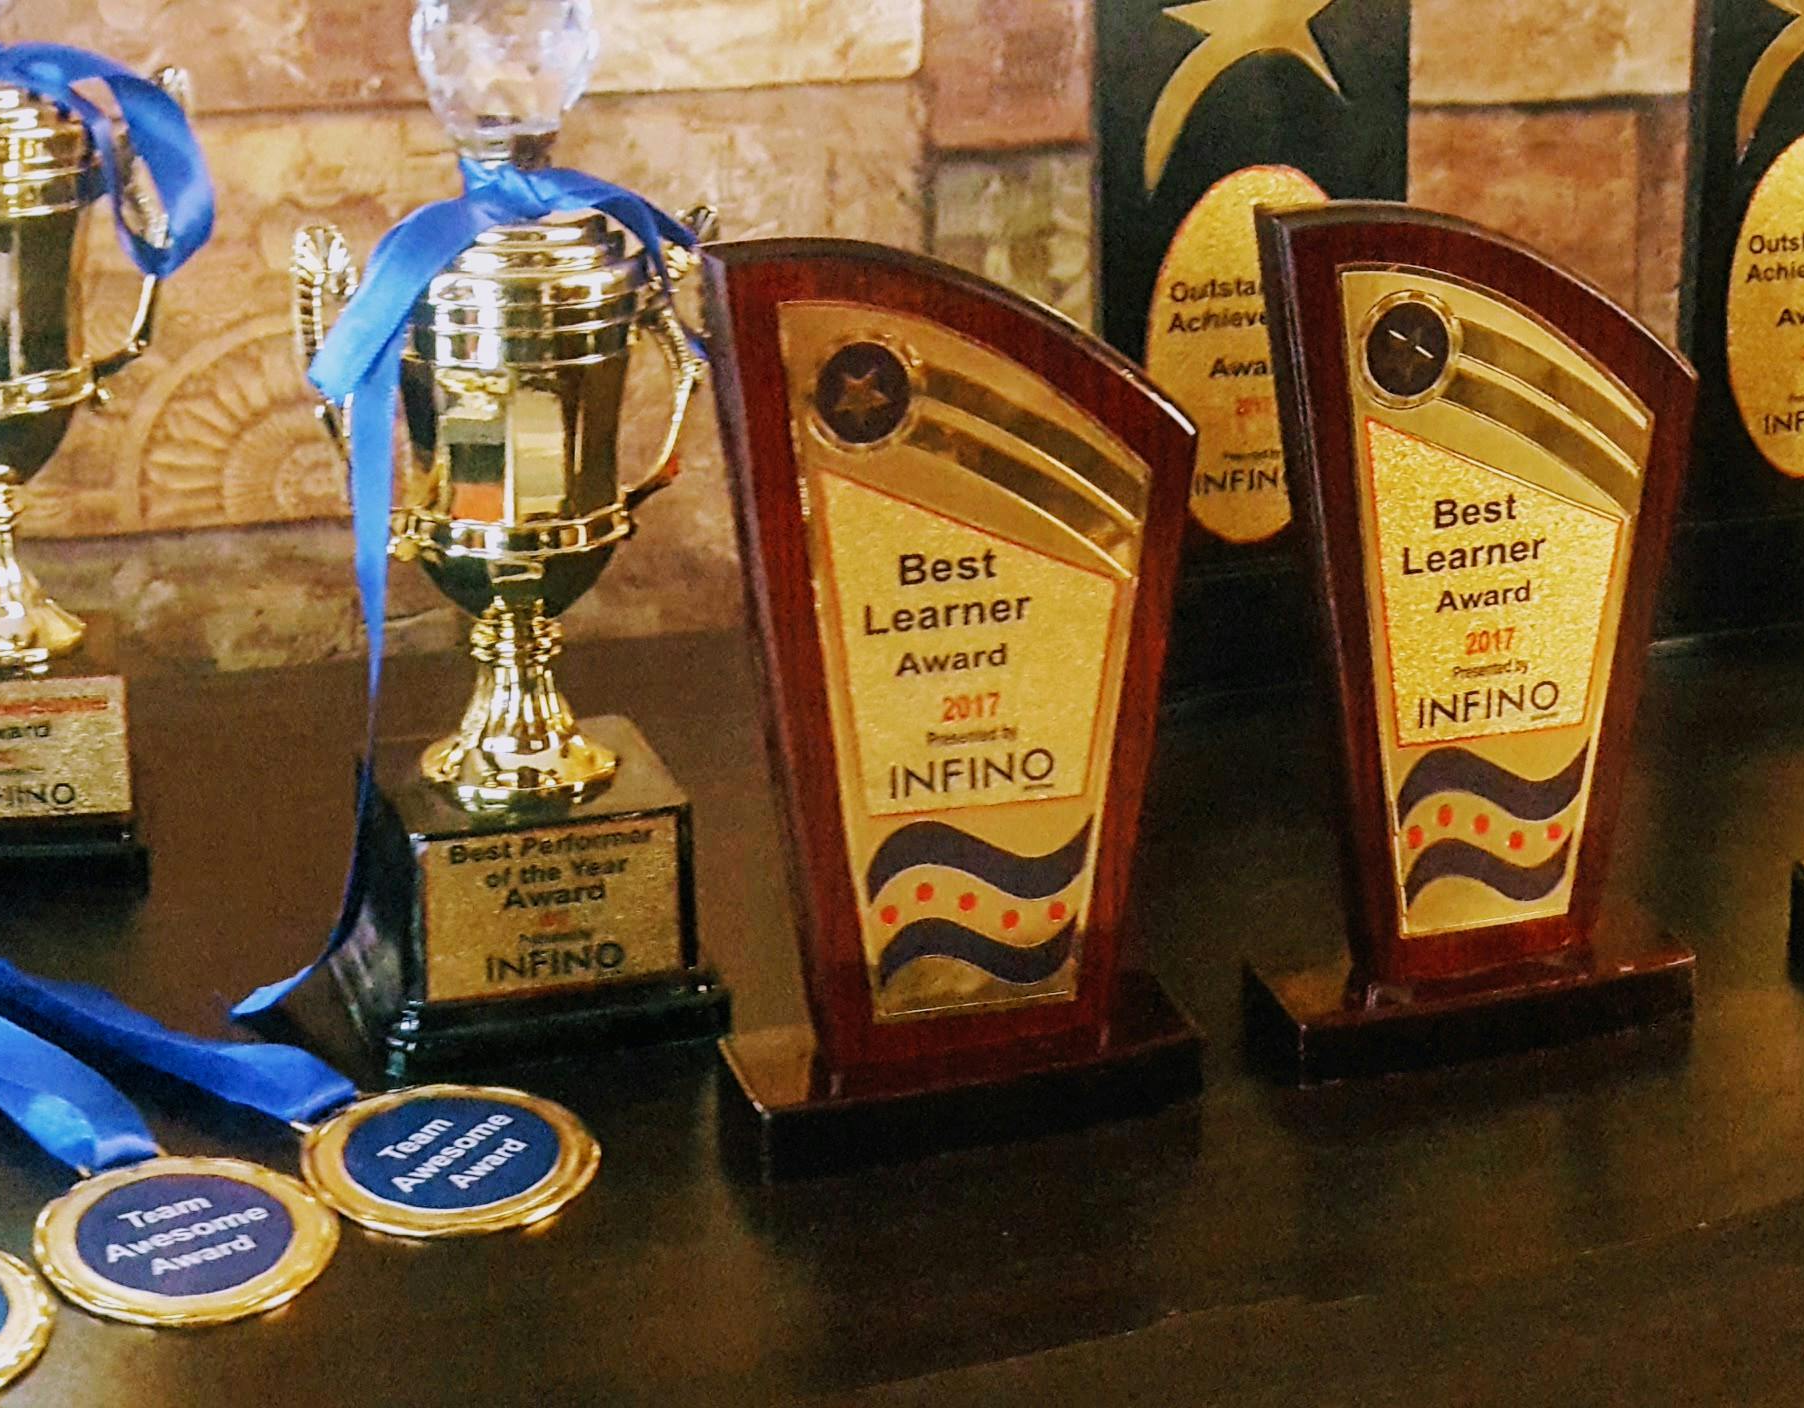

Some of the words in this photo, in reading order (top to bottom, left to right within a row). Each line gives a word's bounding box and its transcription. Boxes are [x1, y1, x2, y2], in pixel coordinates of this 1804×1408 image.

[1170, 279, 1258, 302] Outsta
[1167, 310, 1269, 333] Achieve
[1209, 357, 1268, 378] Awa
[1194, 468, 1279, 496] INFIN
[1434, 494, 1517, 529] Best
[899, 550, 997, 586] Best
[1403, 538, 1546, 575] Learner
[1436, 580, 1531, 613] Award
[863, 596, 1032, 636] Learner
[1465, 627, 1515, 656] 2017
[895, 643, 1008, 677] Award
[941, 691, 1001, 722] 2017
[1419, 680, 1559, 728] INFINO
[889, 748, 1054, 799] INFINO
[449, 840, 513, 865] Best
[485, 866, 511, 888] of
[520, 863, 562, 884] the
[572, 857, 628, 877] Year
[503, 880, 606, 910] Award
[486, 941, 626, 981] INFINO
[376, 1118, 455, 1160] Team
[391, 1114, 514, 1193] Awesome
[448, 1137, 530, 1190] Award
[117, 1197, 213, 1228] Team
[105, 1207, 270, 1264] Awesome
[151, 1234, 257, 1276] Award
